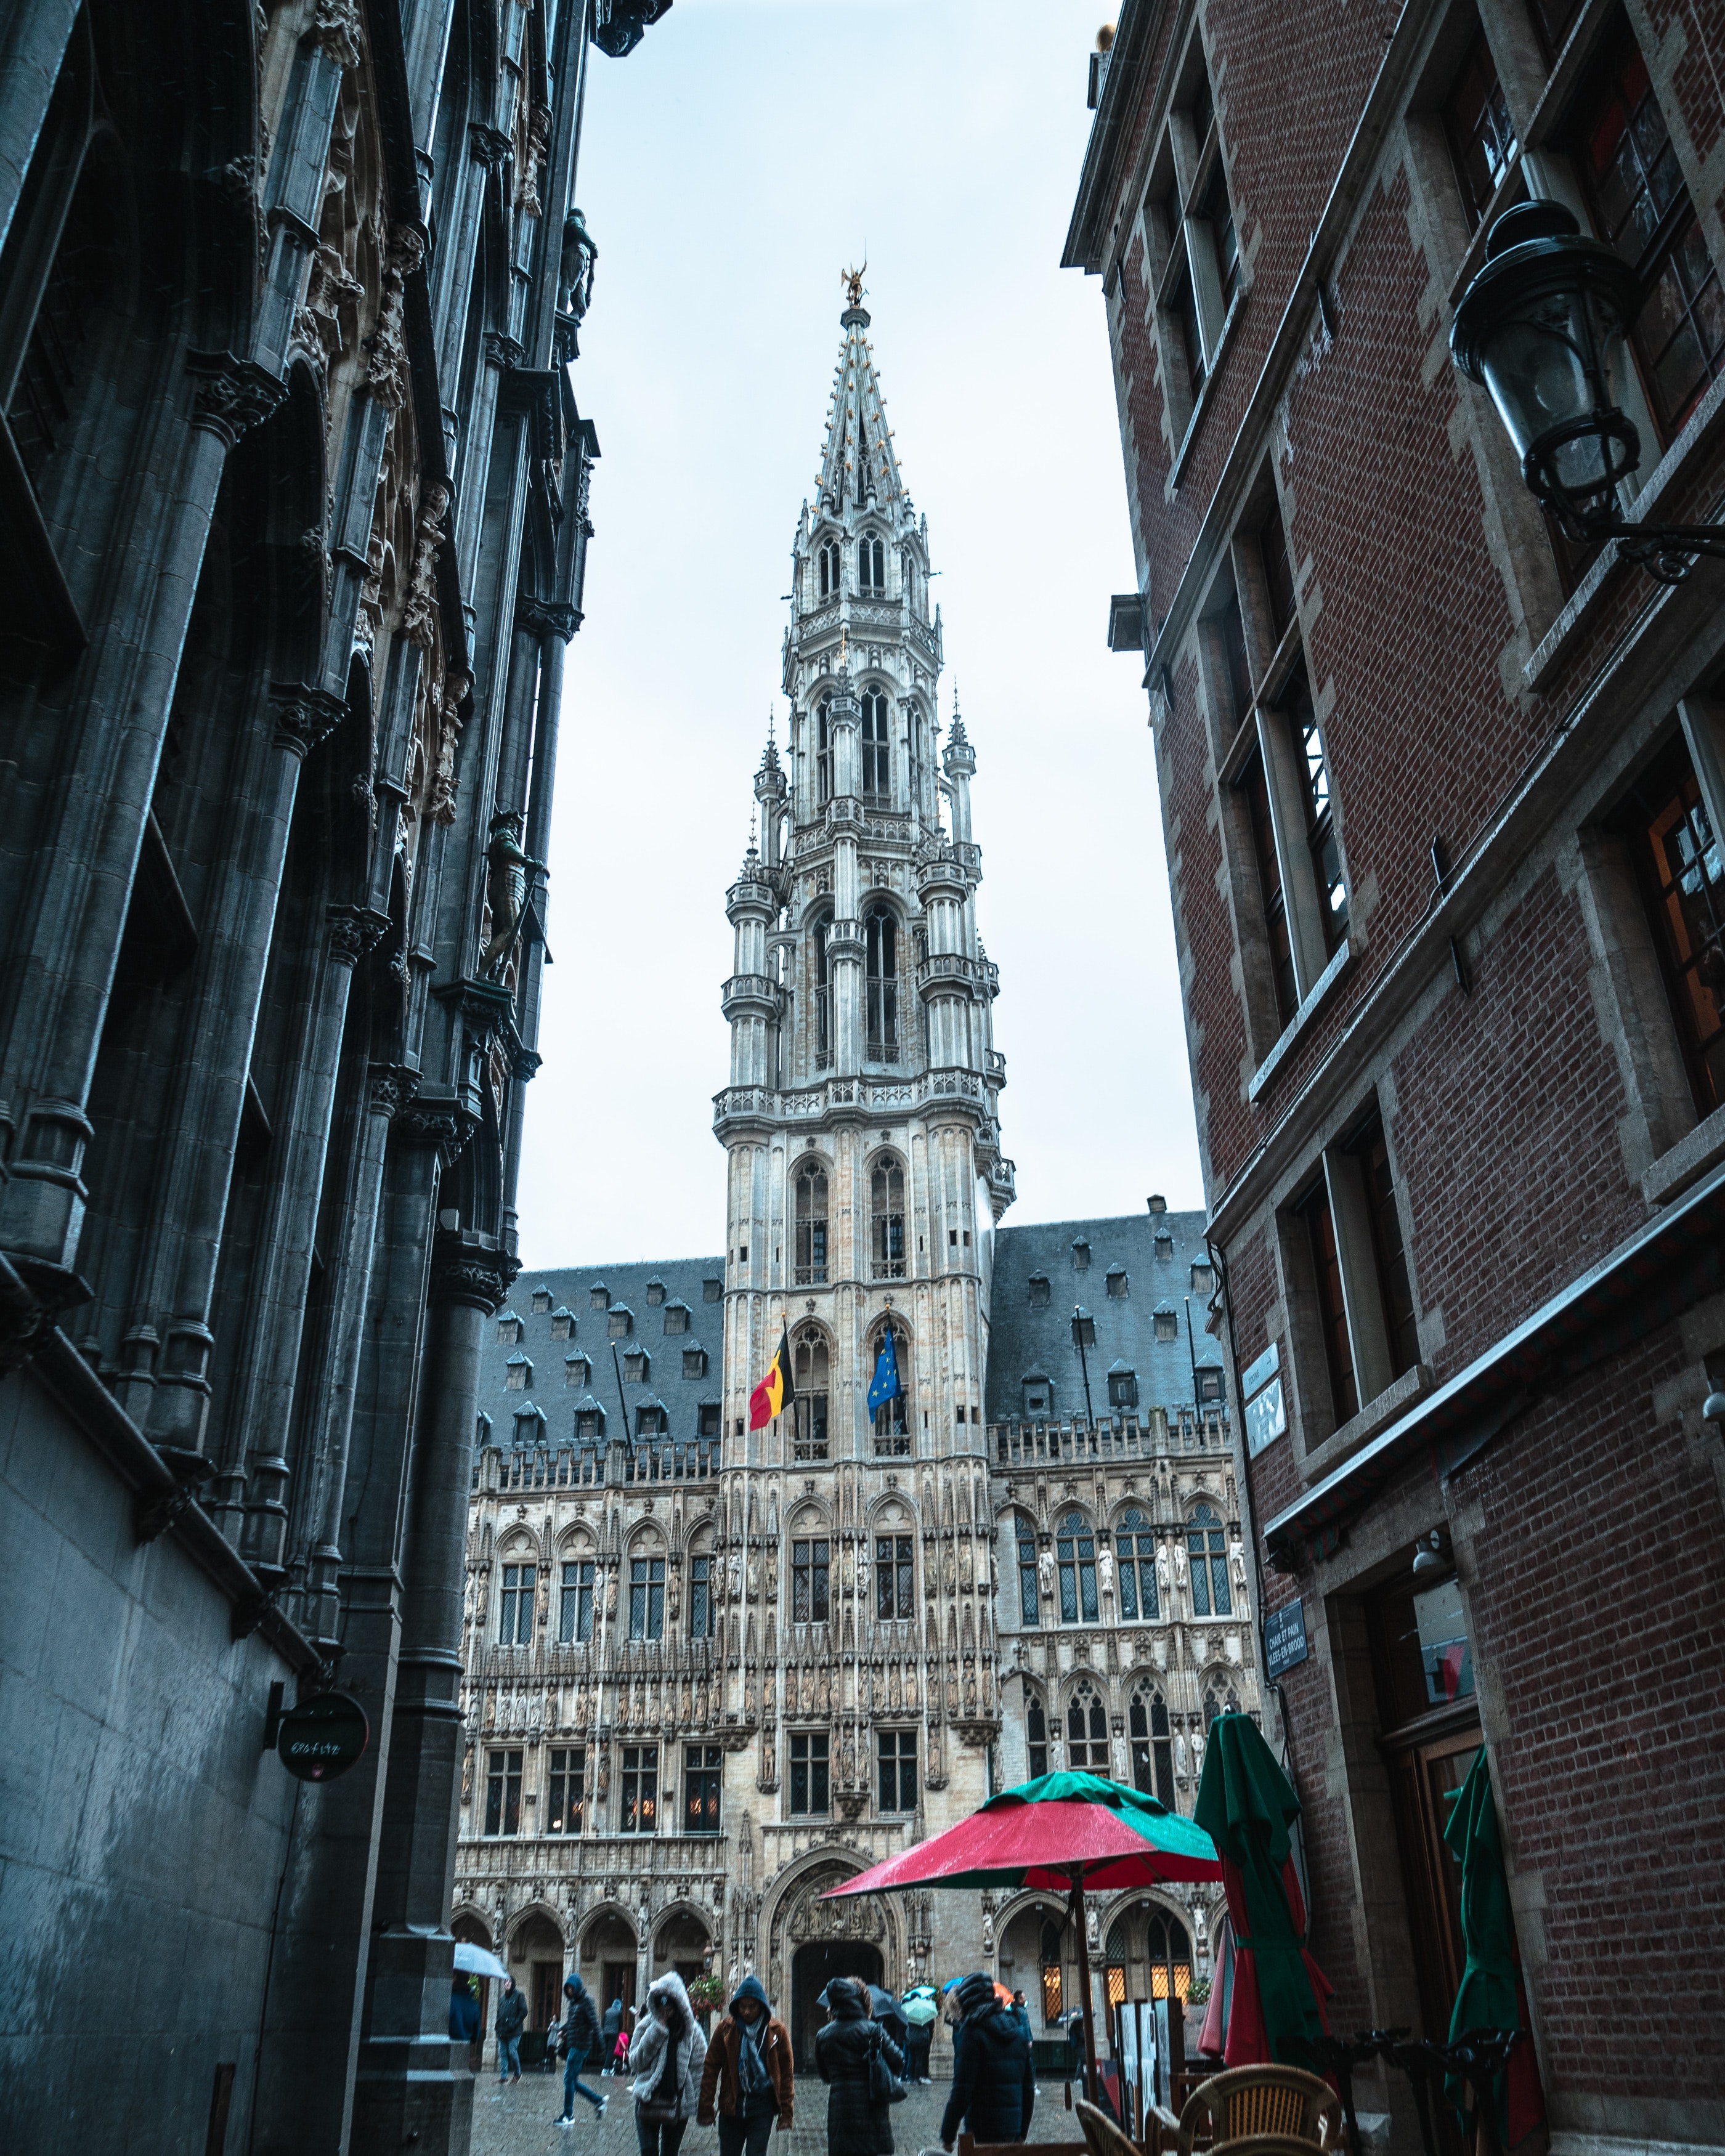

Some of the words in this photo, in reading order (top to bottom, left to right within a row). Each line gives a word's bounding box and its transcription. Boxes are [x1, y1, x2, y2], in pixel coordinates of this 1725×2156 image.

[1268, 1635, 1304, 1666] VLEES-EN-BROOD
[1269, 1632, 1281, 1650] CHAIR
[1281, 1628, 1287, 1642] ET
[1288, 1621, 1299, 1639] PAIN
